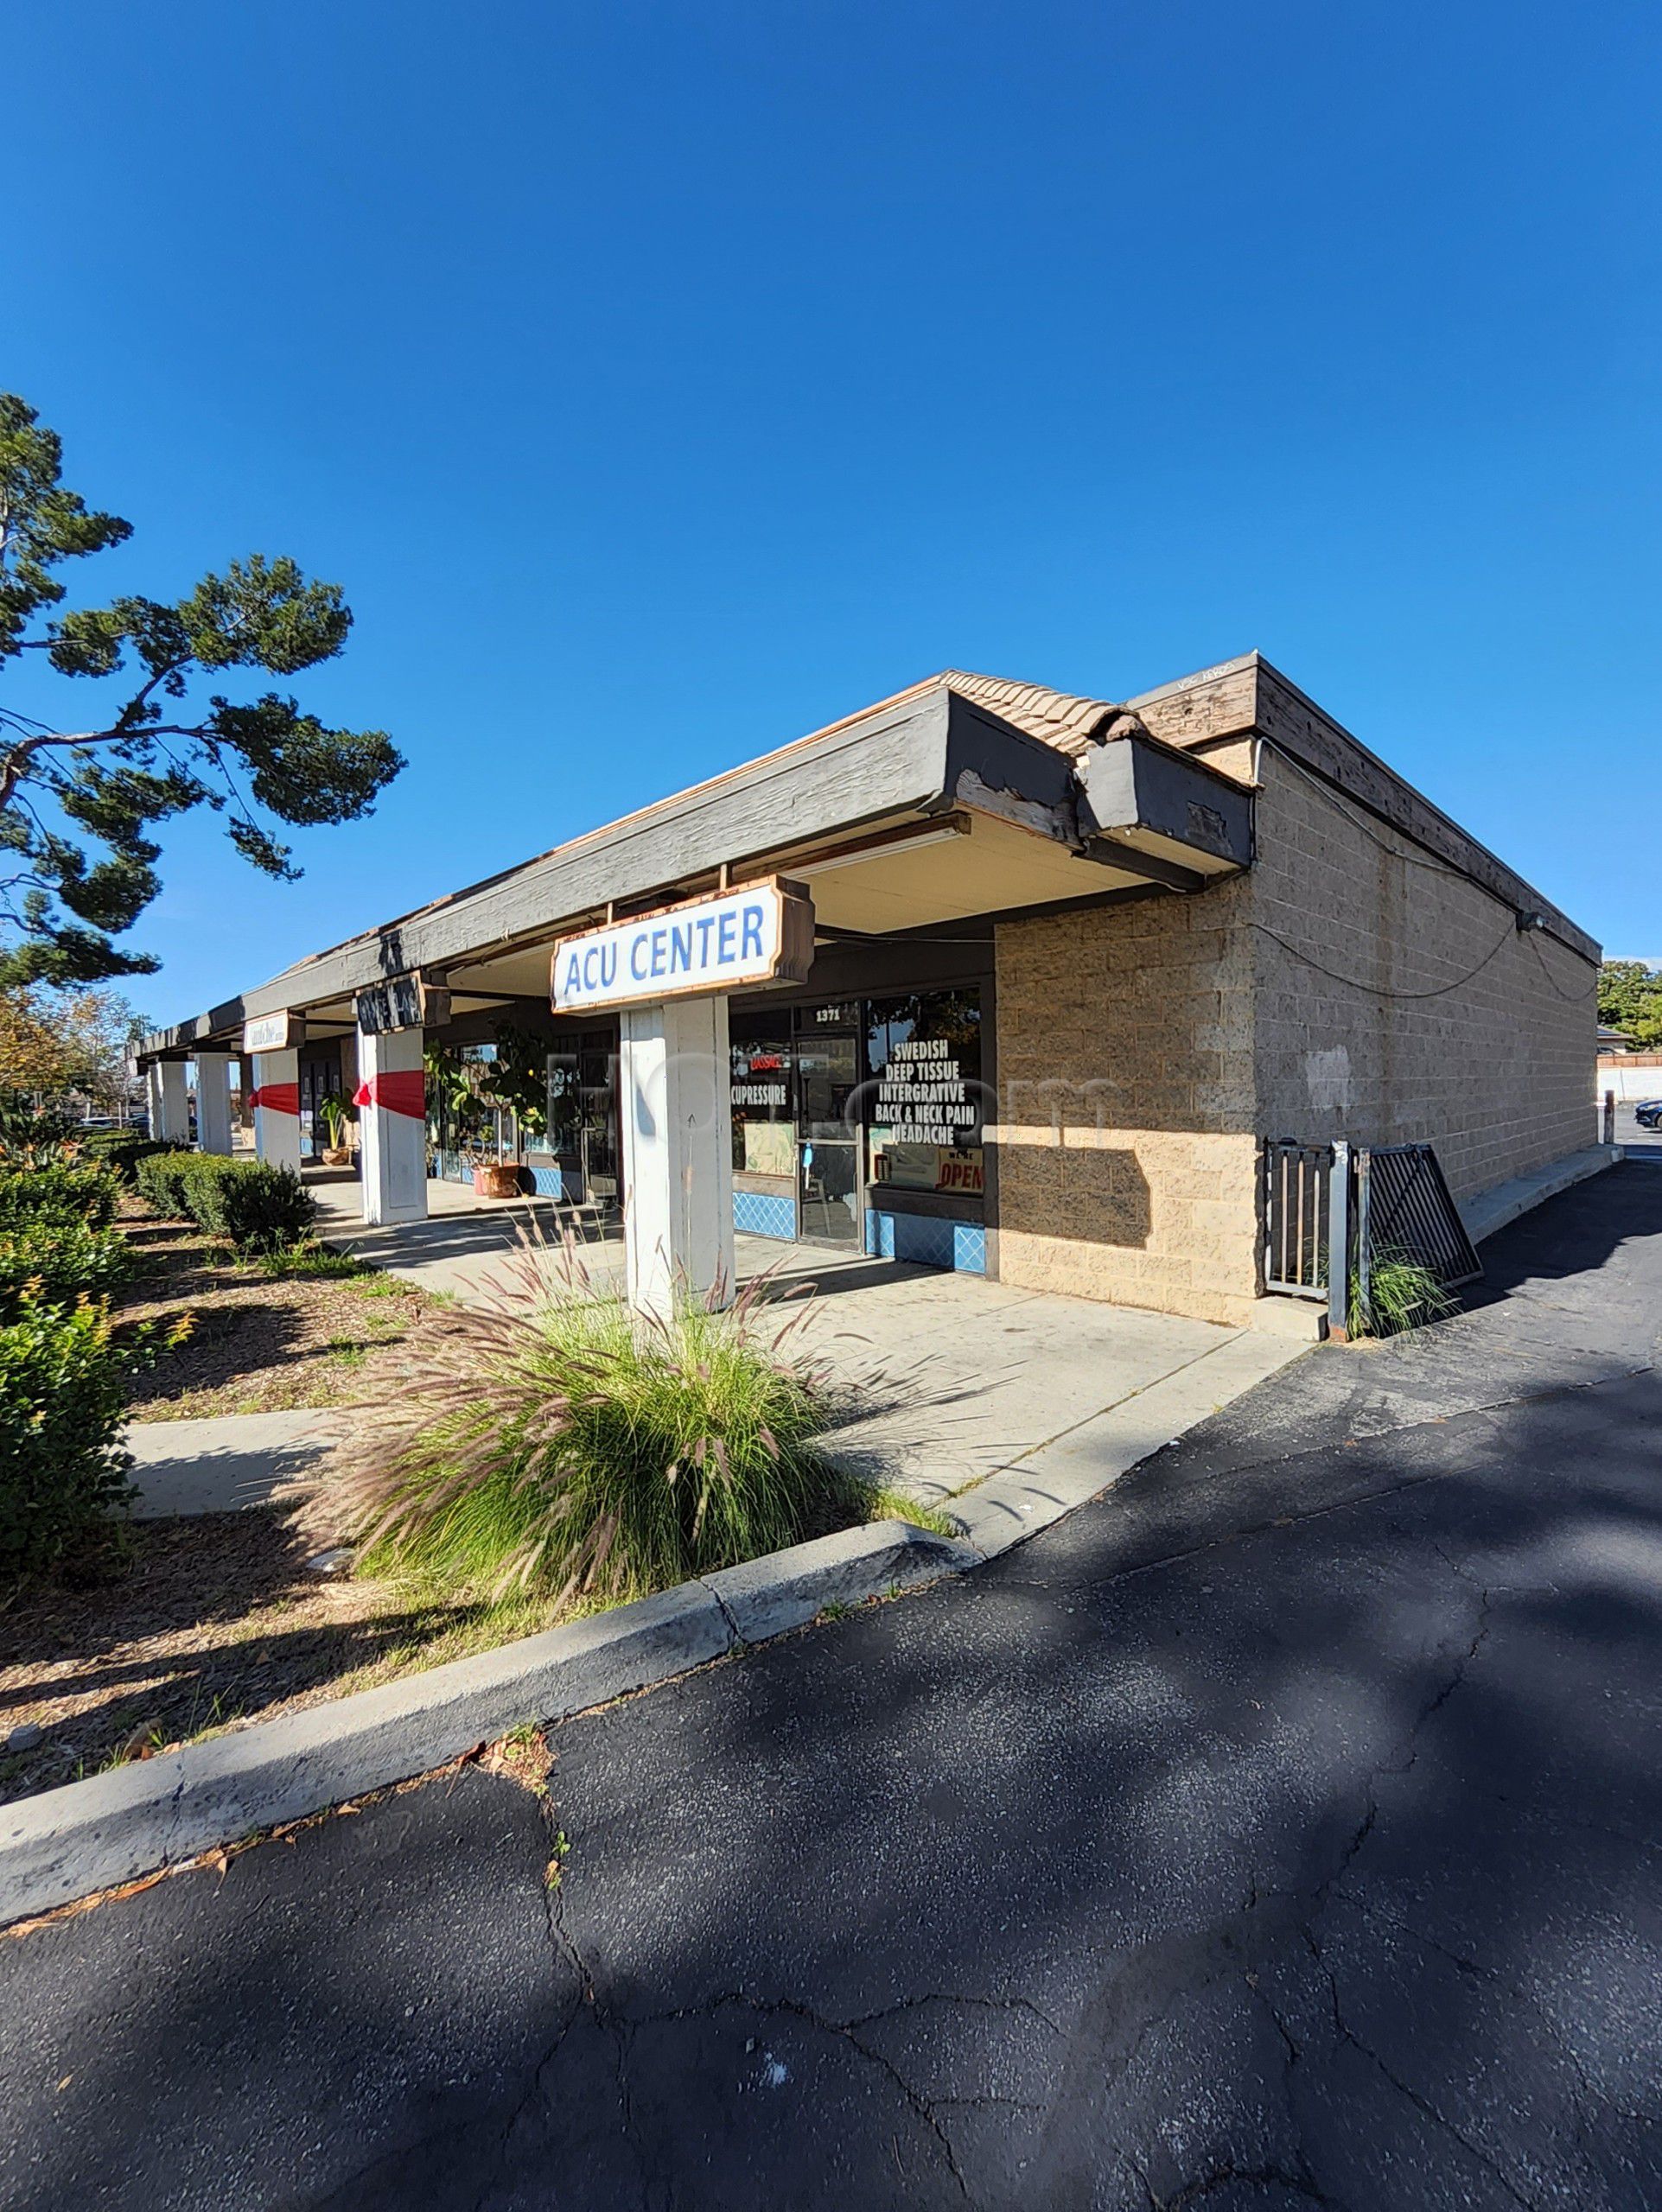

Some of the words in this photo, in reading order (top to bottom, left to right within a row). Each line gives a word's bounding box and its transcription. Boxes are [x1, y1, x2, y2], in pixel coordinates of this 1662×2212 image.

[564, 942, 617, 995] ACU
[631, 905, 765, 982] CENTER
[816, 1008, 840, 1022] 1371
[895, 1039, 948, 1062] SWEDISH
[886, 1063, 914, 1082] DEEP
[916, 1061, 959, 1081] TISSUE
[730, 1084, 786, 1105] CUPRESSURE
[879, 1083, 965, 1103] INTERGRATIVE
[876, 1104, 902, 1122] BACK
[905, 1106, 913, 1123] &
[915, 1105, 944, 1124] NECK
[946, 1106, 975, 1125] PAIN
[892, 1124, 954, 1146] HEADACHE
[935, 1163, 983, 1190] OPEN
